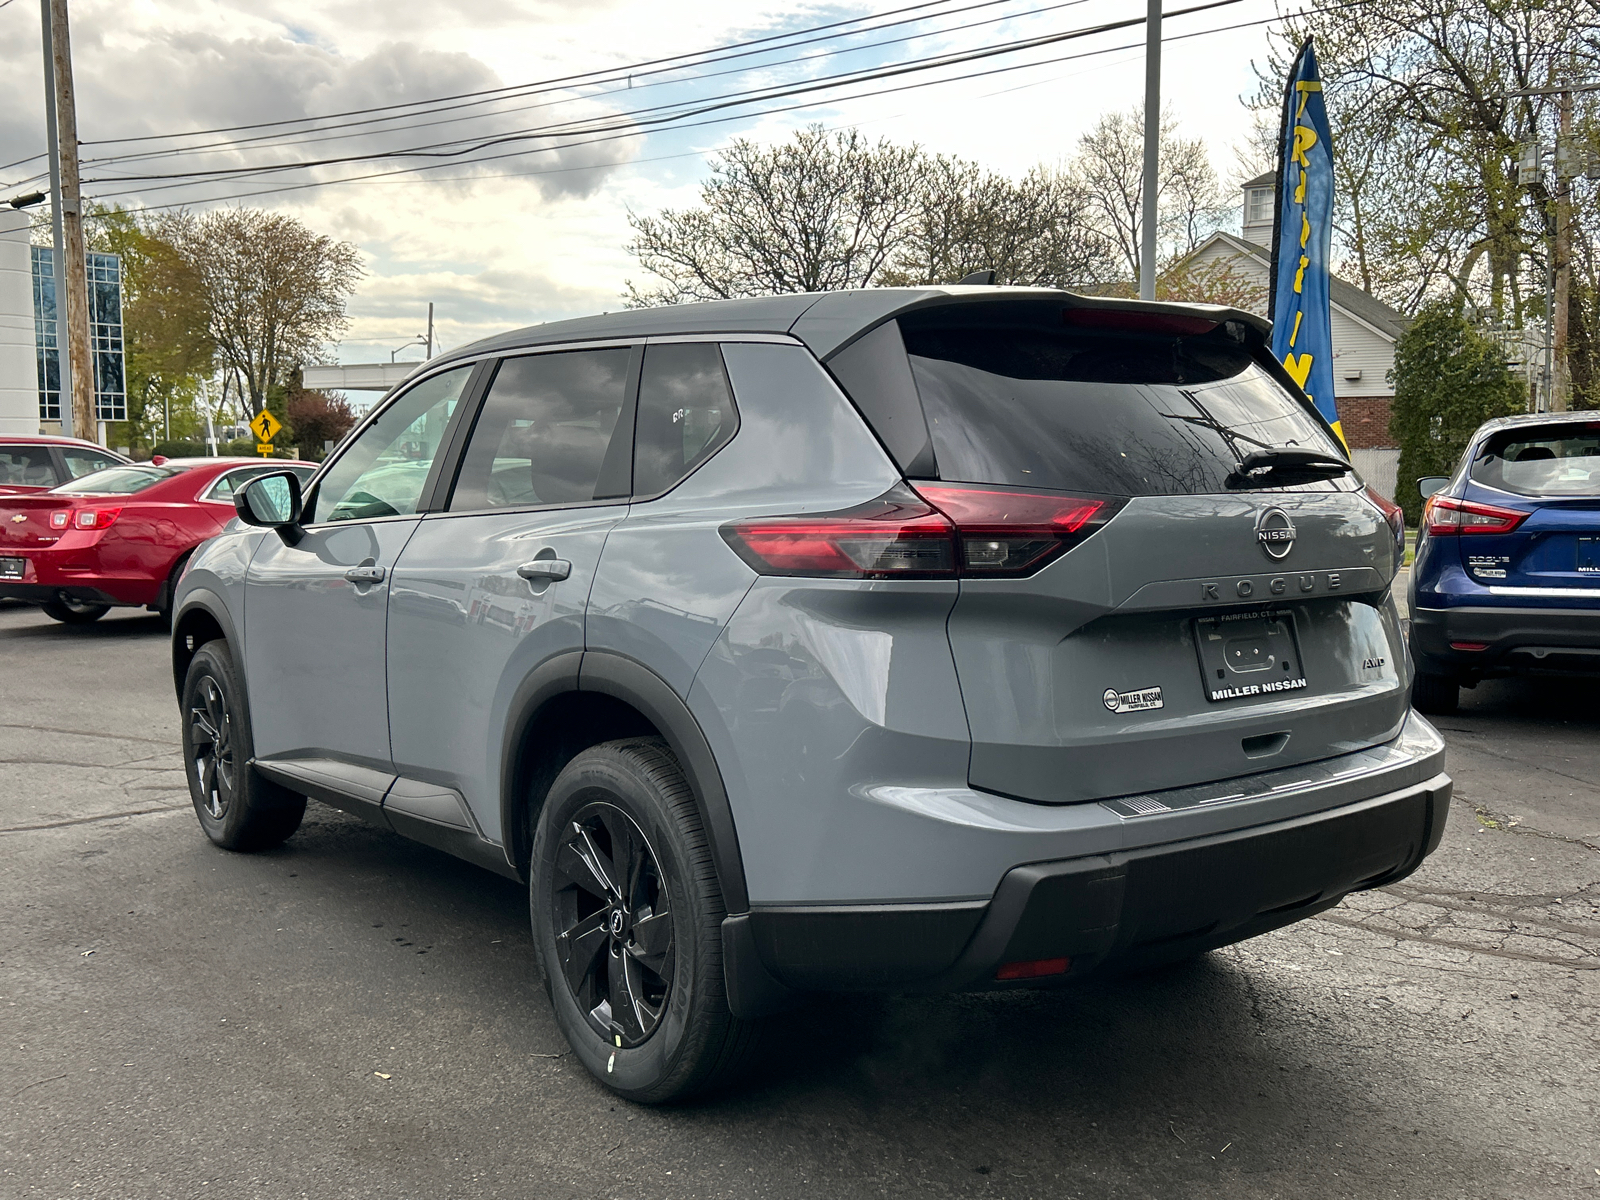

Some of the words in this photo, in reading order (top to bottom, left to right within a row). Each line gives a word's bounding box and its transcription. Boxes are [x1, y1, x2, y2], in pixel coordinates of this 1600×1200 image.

[1258, 528, 1297, 541] NISSAN
[1202, 573, 1342, 600] ROGUE
[1363, 656, 1386, 670] AWD
[1211, 685, 1260, 700] MILLER
[1262, 678, 1307, 693] NISSAN
[1120, 694, 1141, 705] MILLER
[1142, 692, 1162, 702] NISSAN
